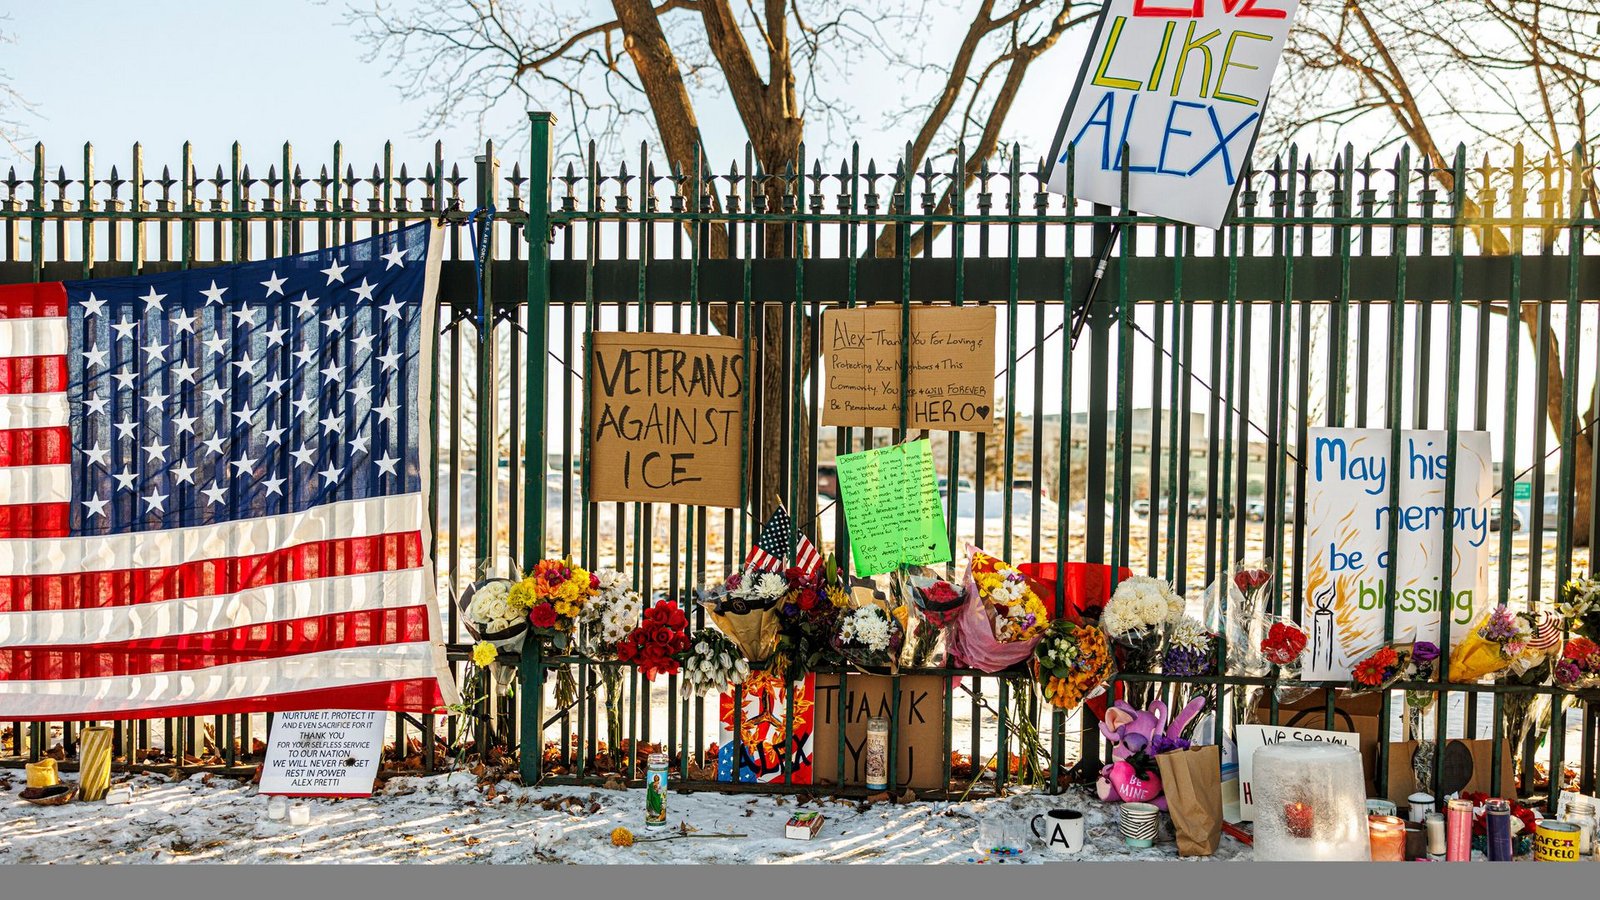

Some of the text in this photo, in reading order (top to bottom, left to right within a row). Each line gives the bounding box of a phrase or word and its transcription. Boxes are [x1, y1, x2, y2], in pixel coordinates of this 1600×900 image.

[1091, 16, 1273, 106] LIKE
[1059, 92, 1259, 185] ALEX
[911, 331, 926, 345] You
[930, 331, 944, 344] For
[946, 334, 976, 352] Loving
[596, 348, 743, 398] VETERANS
[832, 354, 872, 373] Protecting
[876, 358, 893, 372] Your
[942, 358, 963, 370] This
[881, 380, 899, 394] You
[948, 382, 987, 396] FOREVER
[830, 398, 840, 410] Be
[844, 400, 888, 412] Remembered
[915, 400, 976, 422] HERO
[596, 402, 739, 446] AGAINST
[624, 450, 702, 489] ICE
[1315, 436, 1449, 495] May his
[1375, 506, 1488, 548] memory
[1330, 542, 1364, 572] be
[1358, 578, 1473, 625] blessing
[282, 712, 319, 720] NURTURE
[331, 712, 366, 720] PROTECT
[368, 712, 375, 720] IT
[816, 685, 928, 725] THANK
[272, 760, 370, 768] WE WILL NEVER FOGET
[738, 731, 811, 775] ALEX
[1120, 784, 1148, 800] MINE
[1130, 774, 1142, 787] BE
[1050, 823, 1070, 848] A
[1537, 844, 1574, 858] USTELO
